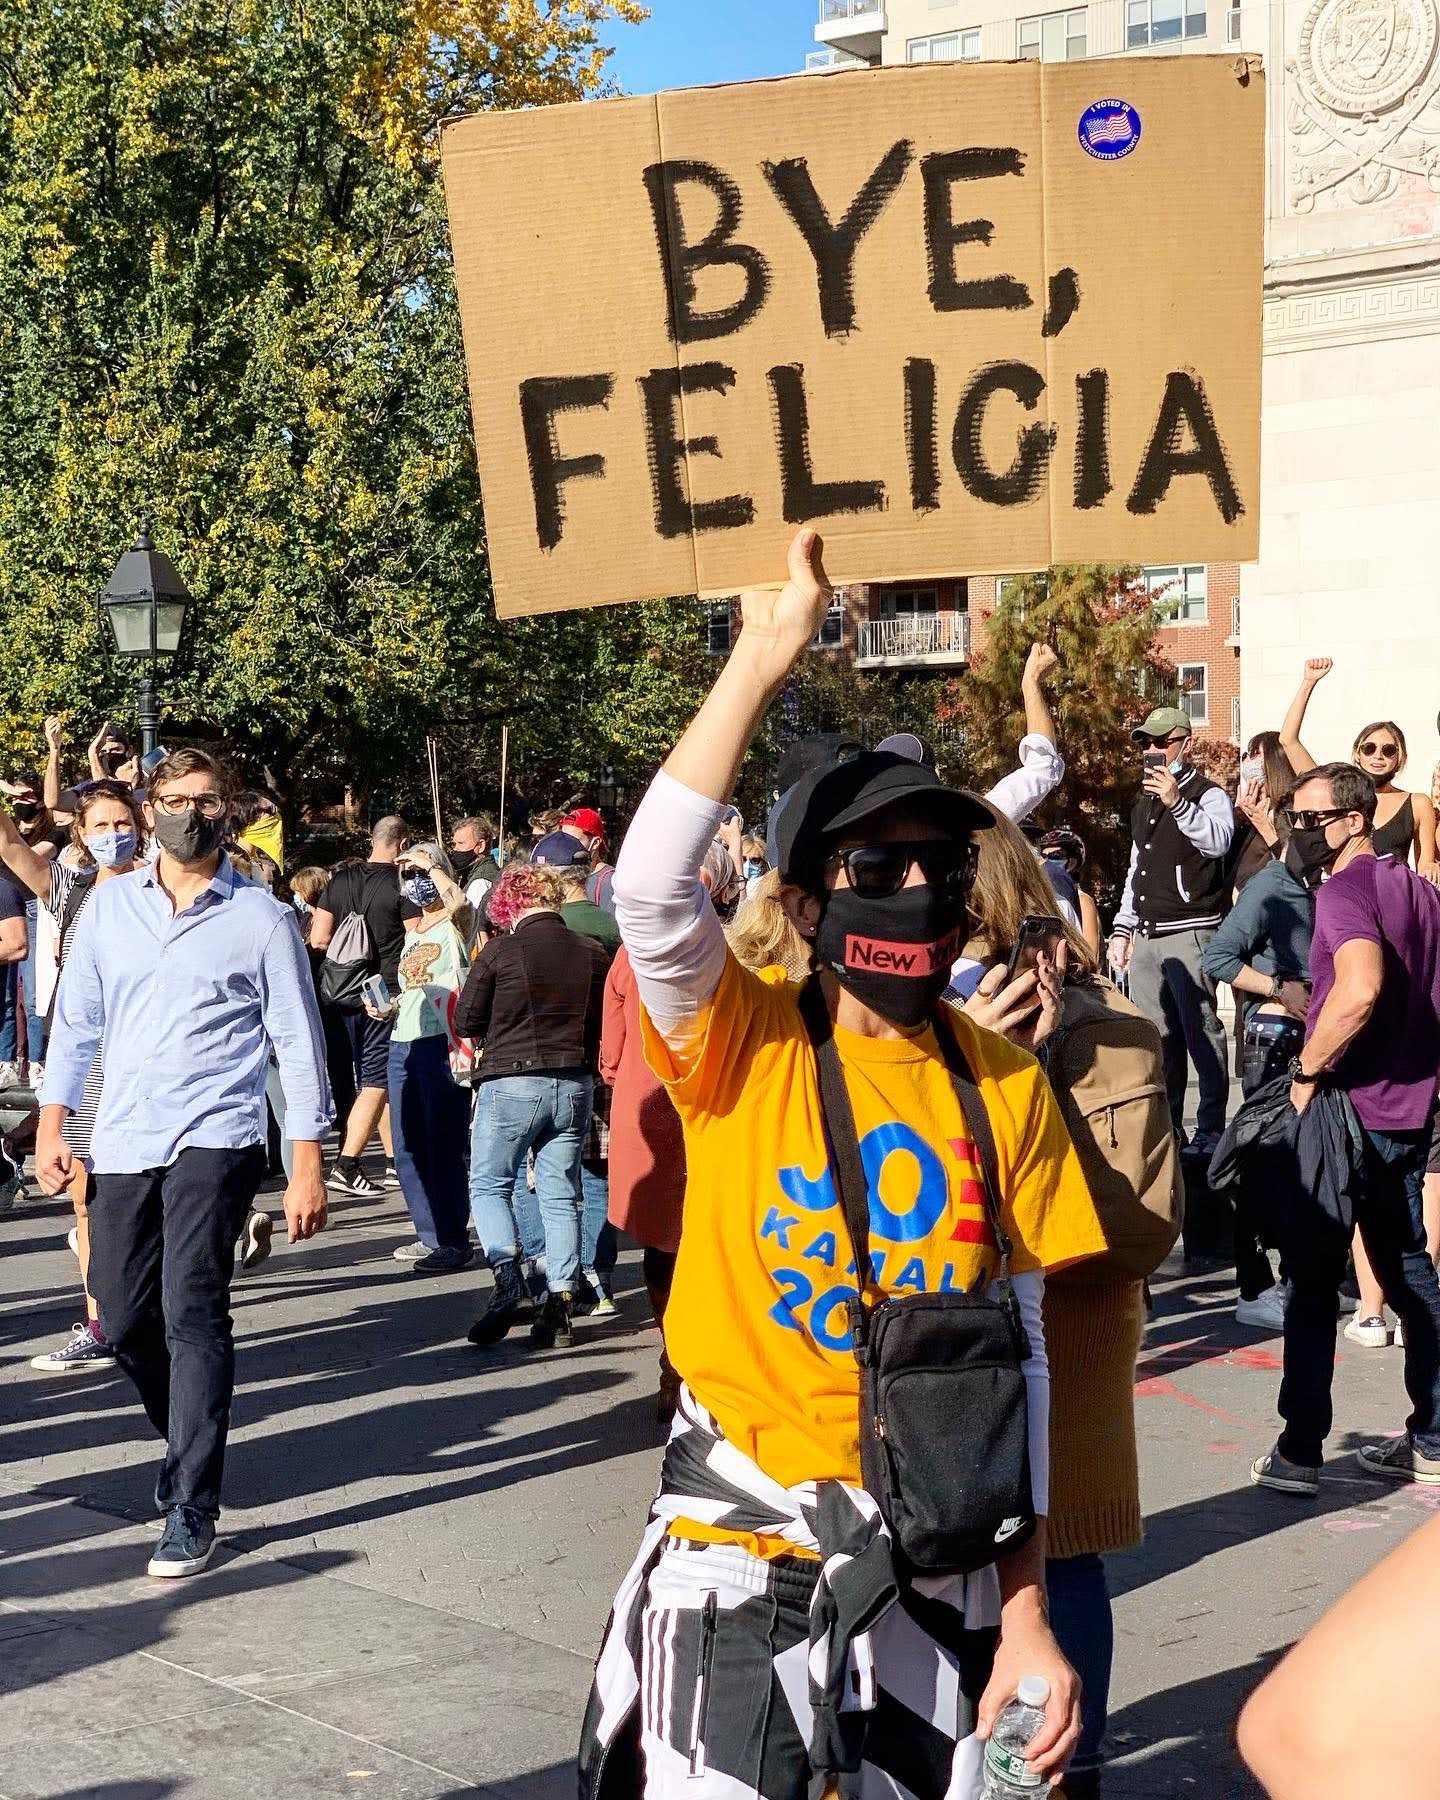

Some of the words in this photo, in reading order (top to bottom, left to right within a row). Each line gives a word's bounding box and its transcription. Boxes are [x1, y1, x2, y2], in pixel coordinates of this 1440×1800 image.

[1095, 100, 1121, 108] VOTED
[1121, 103, 1131, 113] IN
[1080, 134, 1118, 159] WESTCHESTER
[1117, 133, 1139, 157] COUNTY
[642, 138, 1080, 344] BYE,
[519, 357, 1246, 553] FELICIA
[850, 940, 918, 972] New
[1000, 1516, 1022, 1532] NIKE
